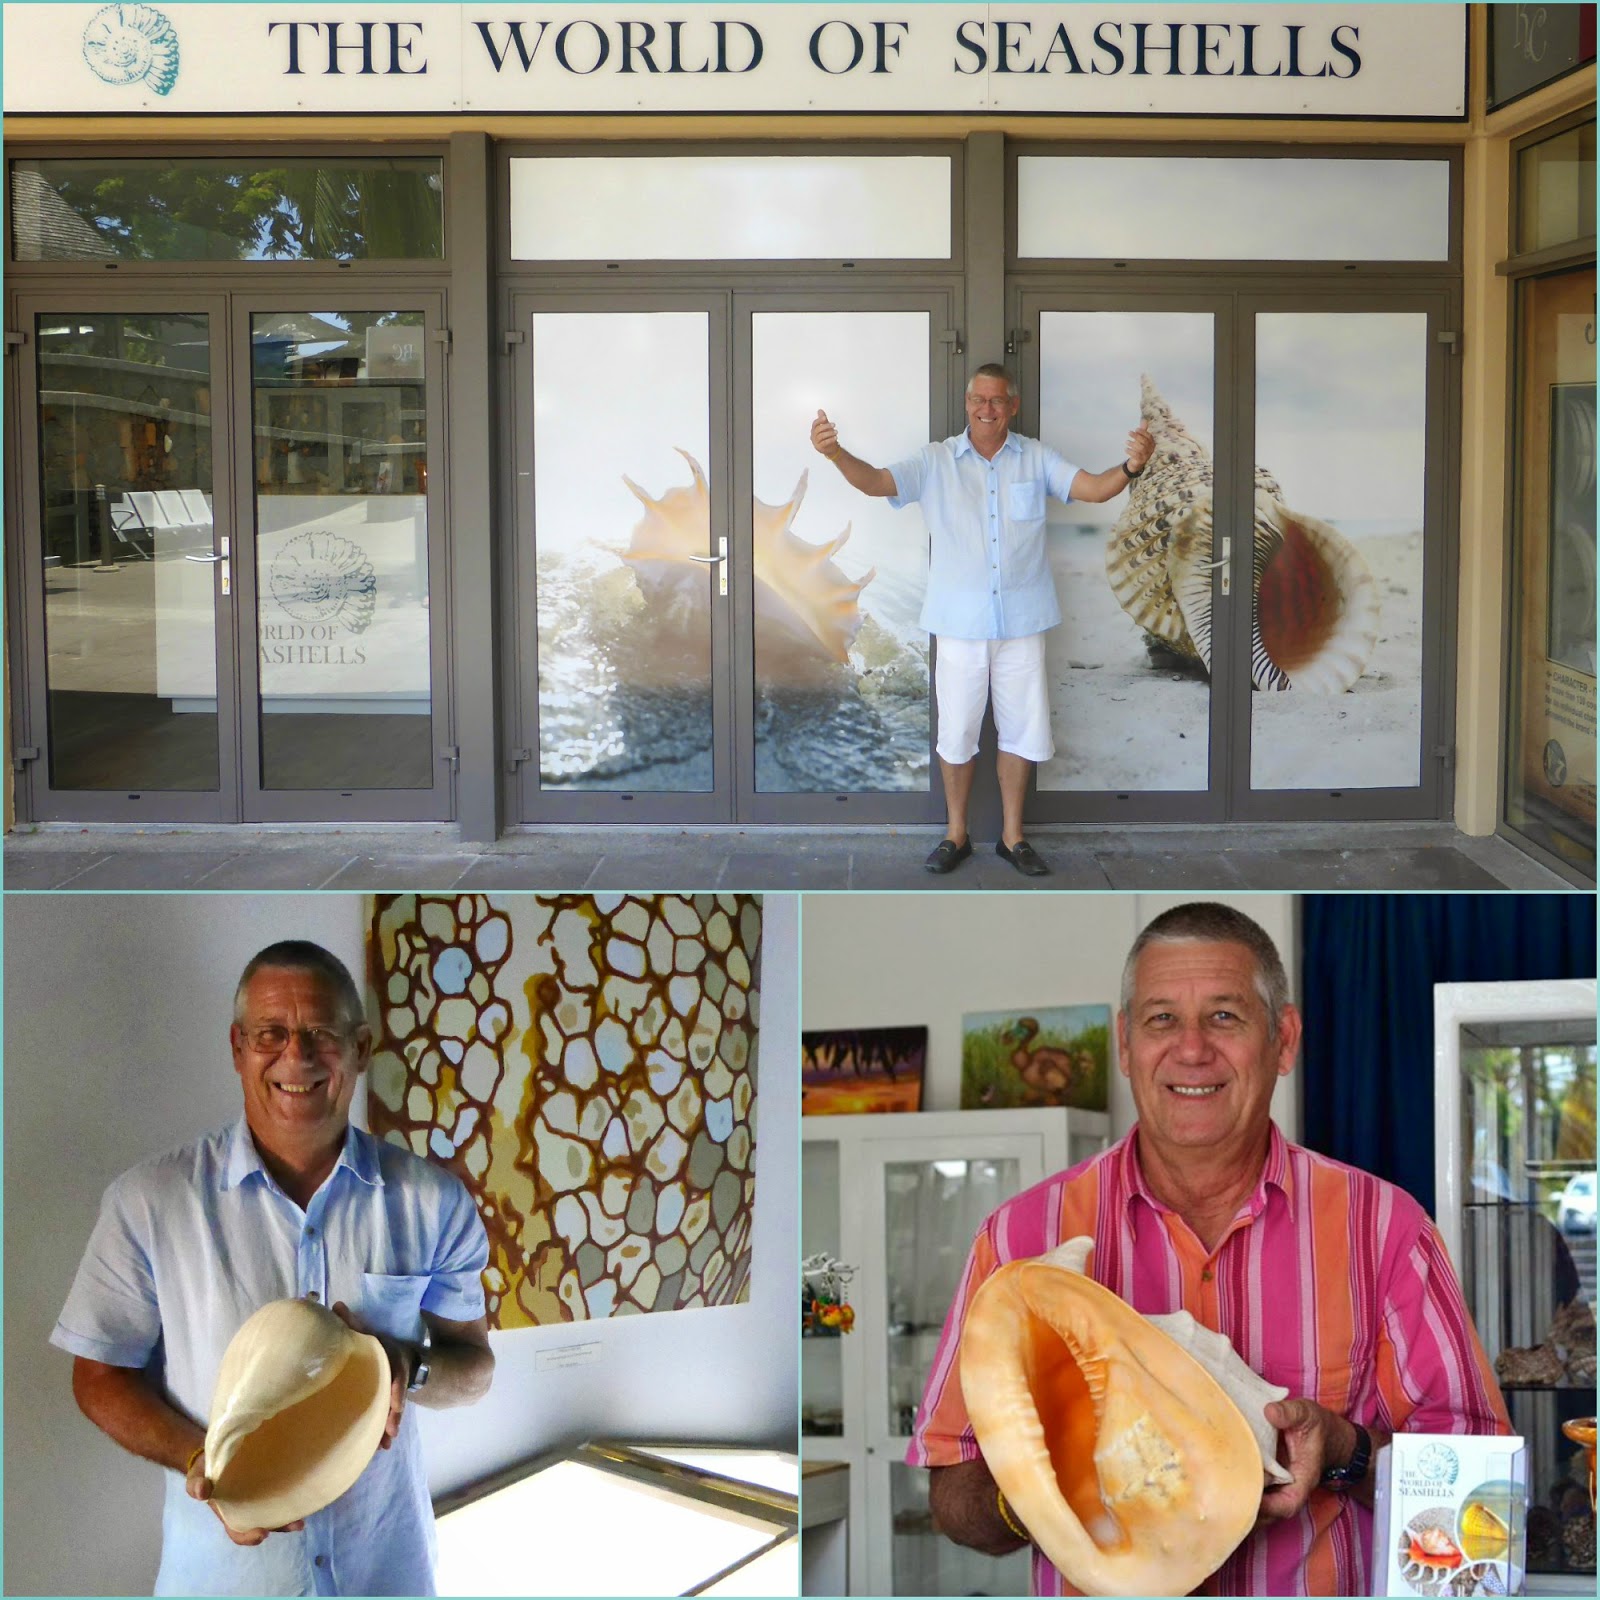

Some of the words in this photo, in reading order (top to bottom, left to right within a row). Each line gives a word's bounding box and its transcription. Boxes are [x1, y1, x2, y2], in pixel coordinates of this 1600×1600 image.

[268, 22, 428, 75] THE
[475, 21, 764, 75] WORLD
[808, 21, 910, 75] OF
[953, 21, 1363, 79] SEASHELLS
[260, 624, 304, 640] RLD
[311, 625, 338, 640] OF
[1399, 1479, 1431, 1487] WORLD
[1398, 1487, 1455, 1497] SEASHELLS
